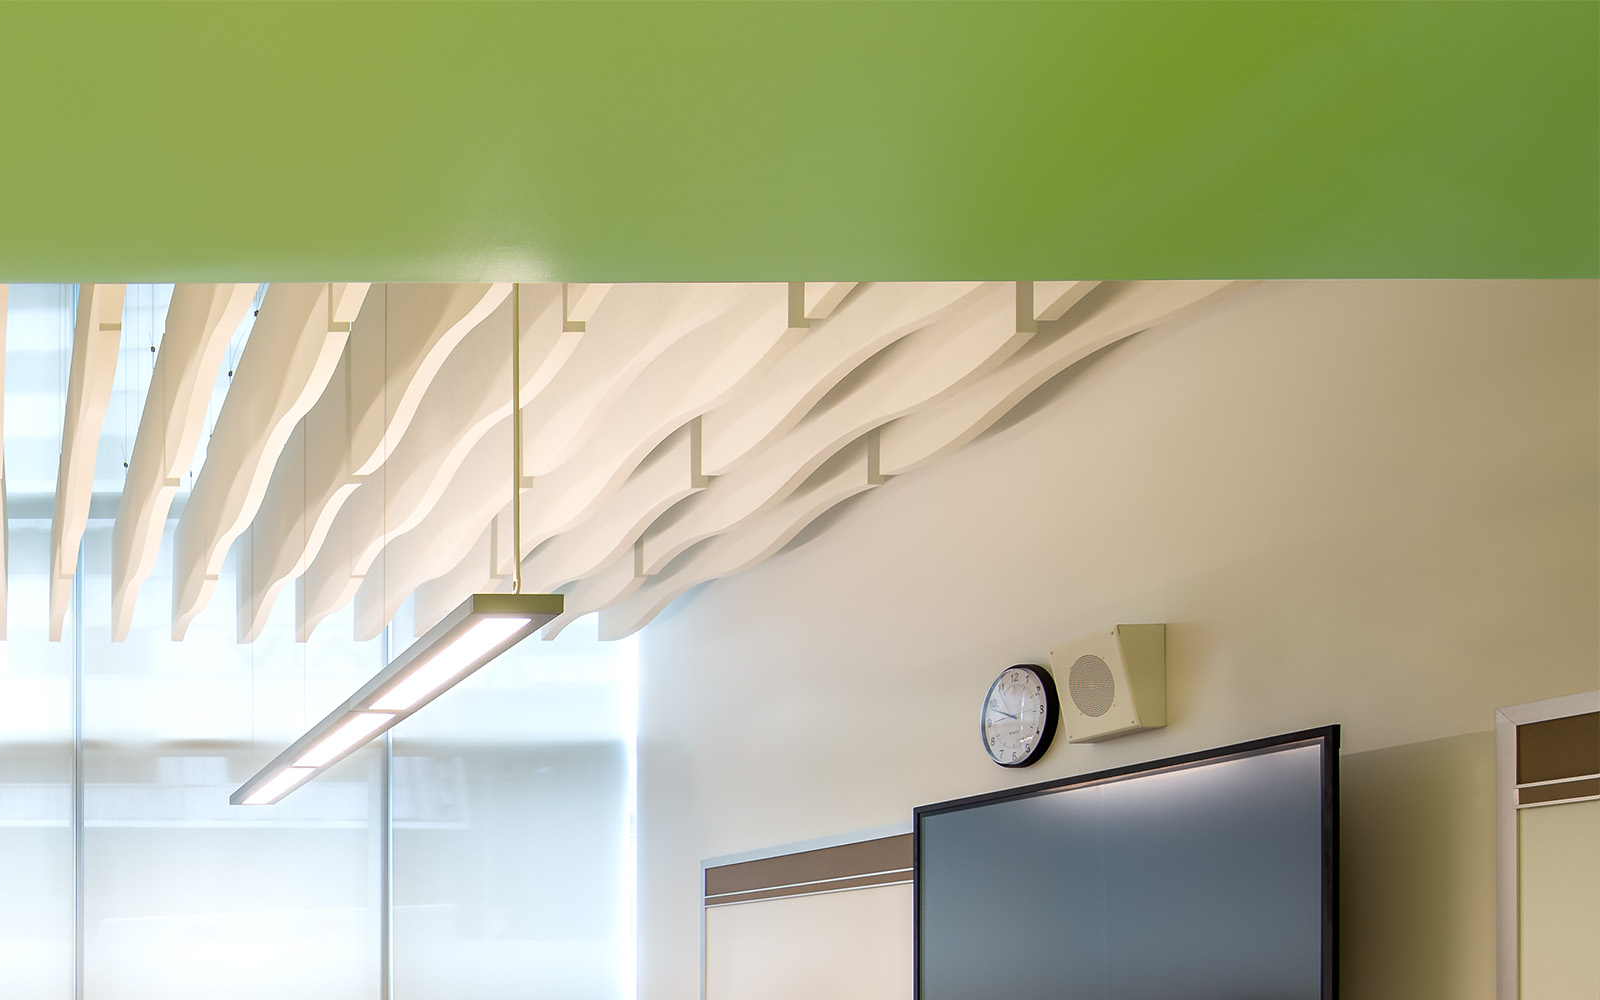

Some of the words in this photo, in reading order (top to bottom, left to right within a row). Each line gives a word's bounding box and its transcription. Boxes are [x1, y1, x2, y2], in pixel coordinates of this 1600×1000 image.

[1010, 672, 1019, 683] 12
[1039, 704, 1045, 715] 3
[986, 718, 992, 728] 9
[990, 737, 996, 747] 8
[1025, 743, 1031, 753] 5
[999, 749, 1004, 759] 7
[1011, 751, 1018, 761] 6
